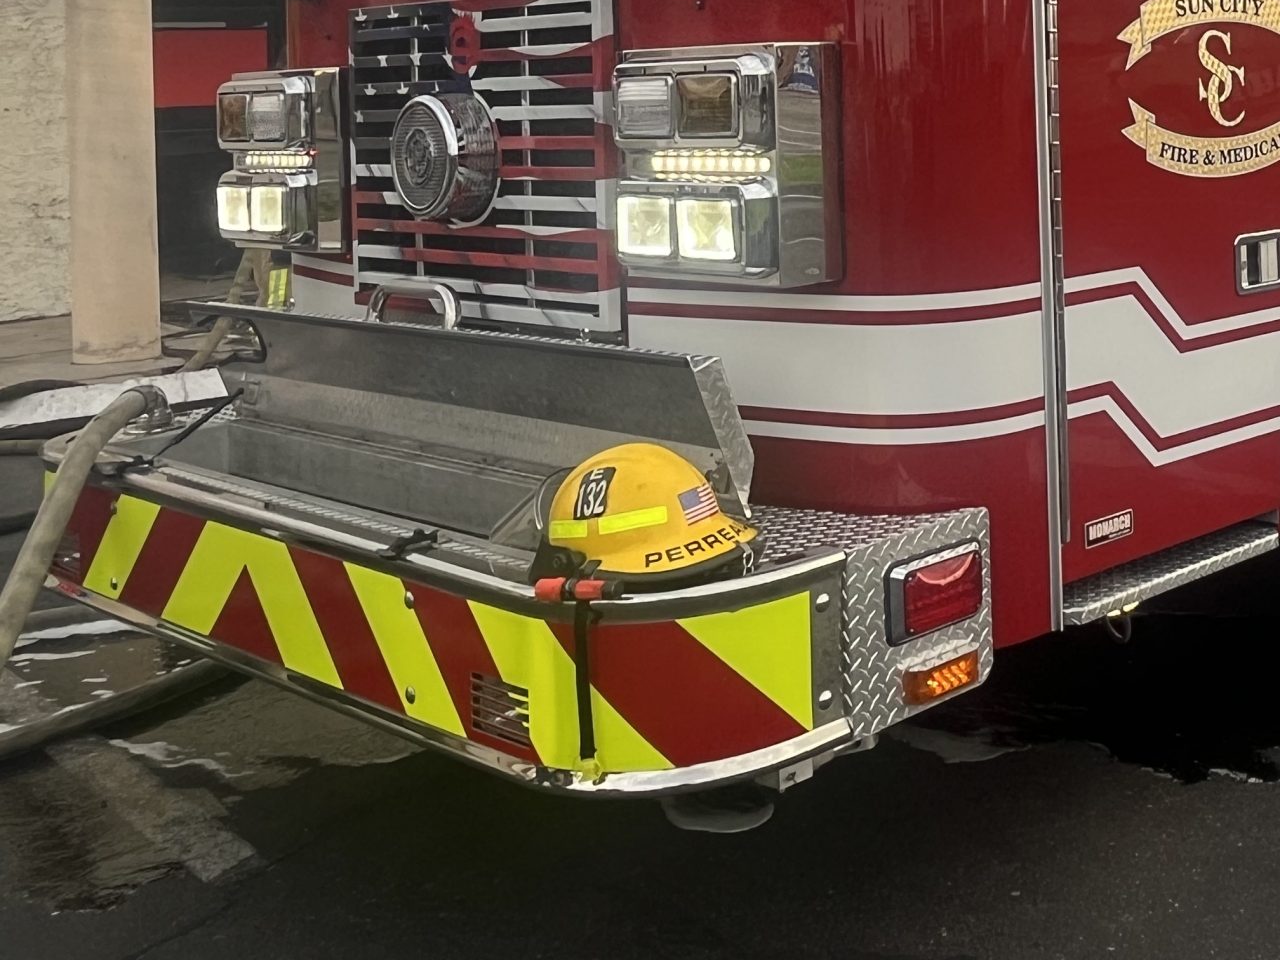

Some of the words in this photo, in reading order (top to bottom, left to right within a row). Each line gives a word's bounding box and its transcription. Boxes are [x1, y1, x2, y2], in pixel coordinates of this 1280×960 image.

[1159, 141, 1199, 165] FIRE
[1203, 152, 1216, 166] &
[589, 469, 604, 480] E
[576, 480, 608, 518] 132
